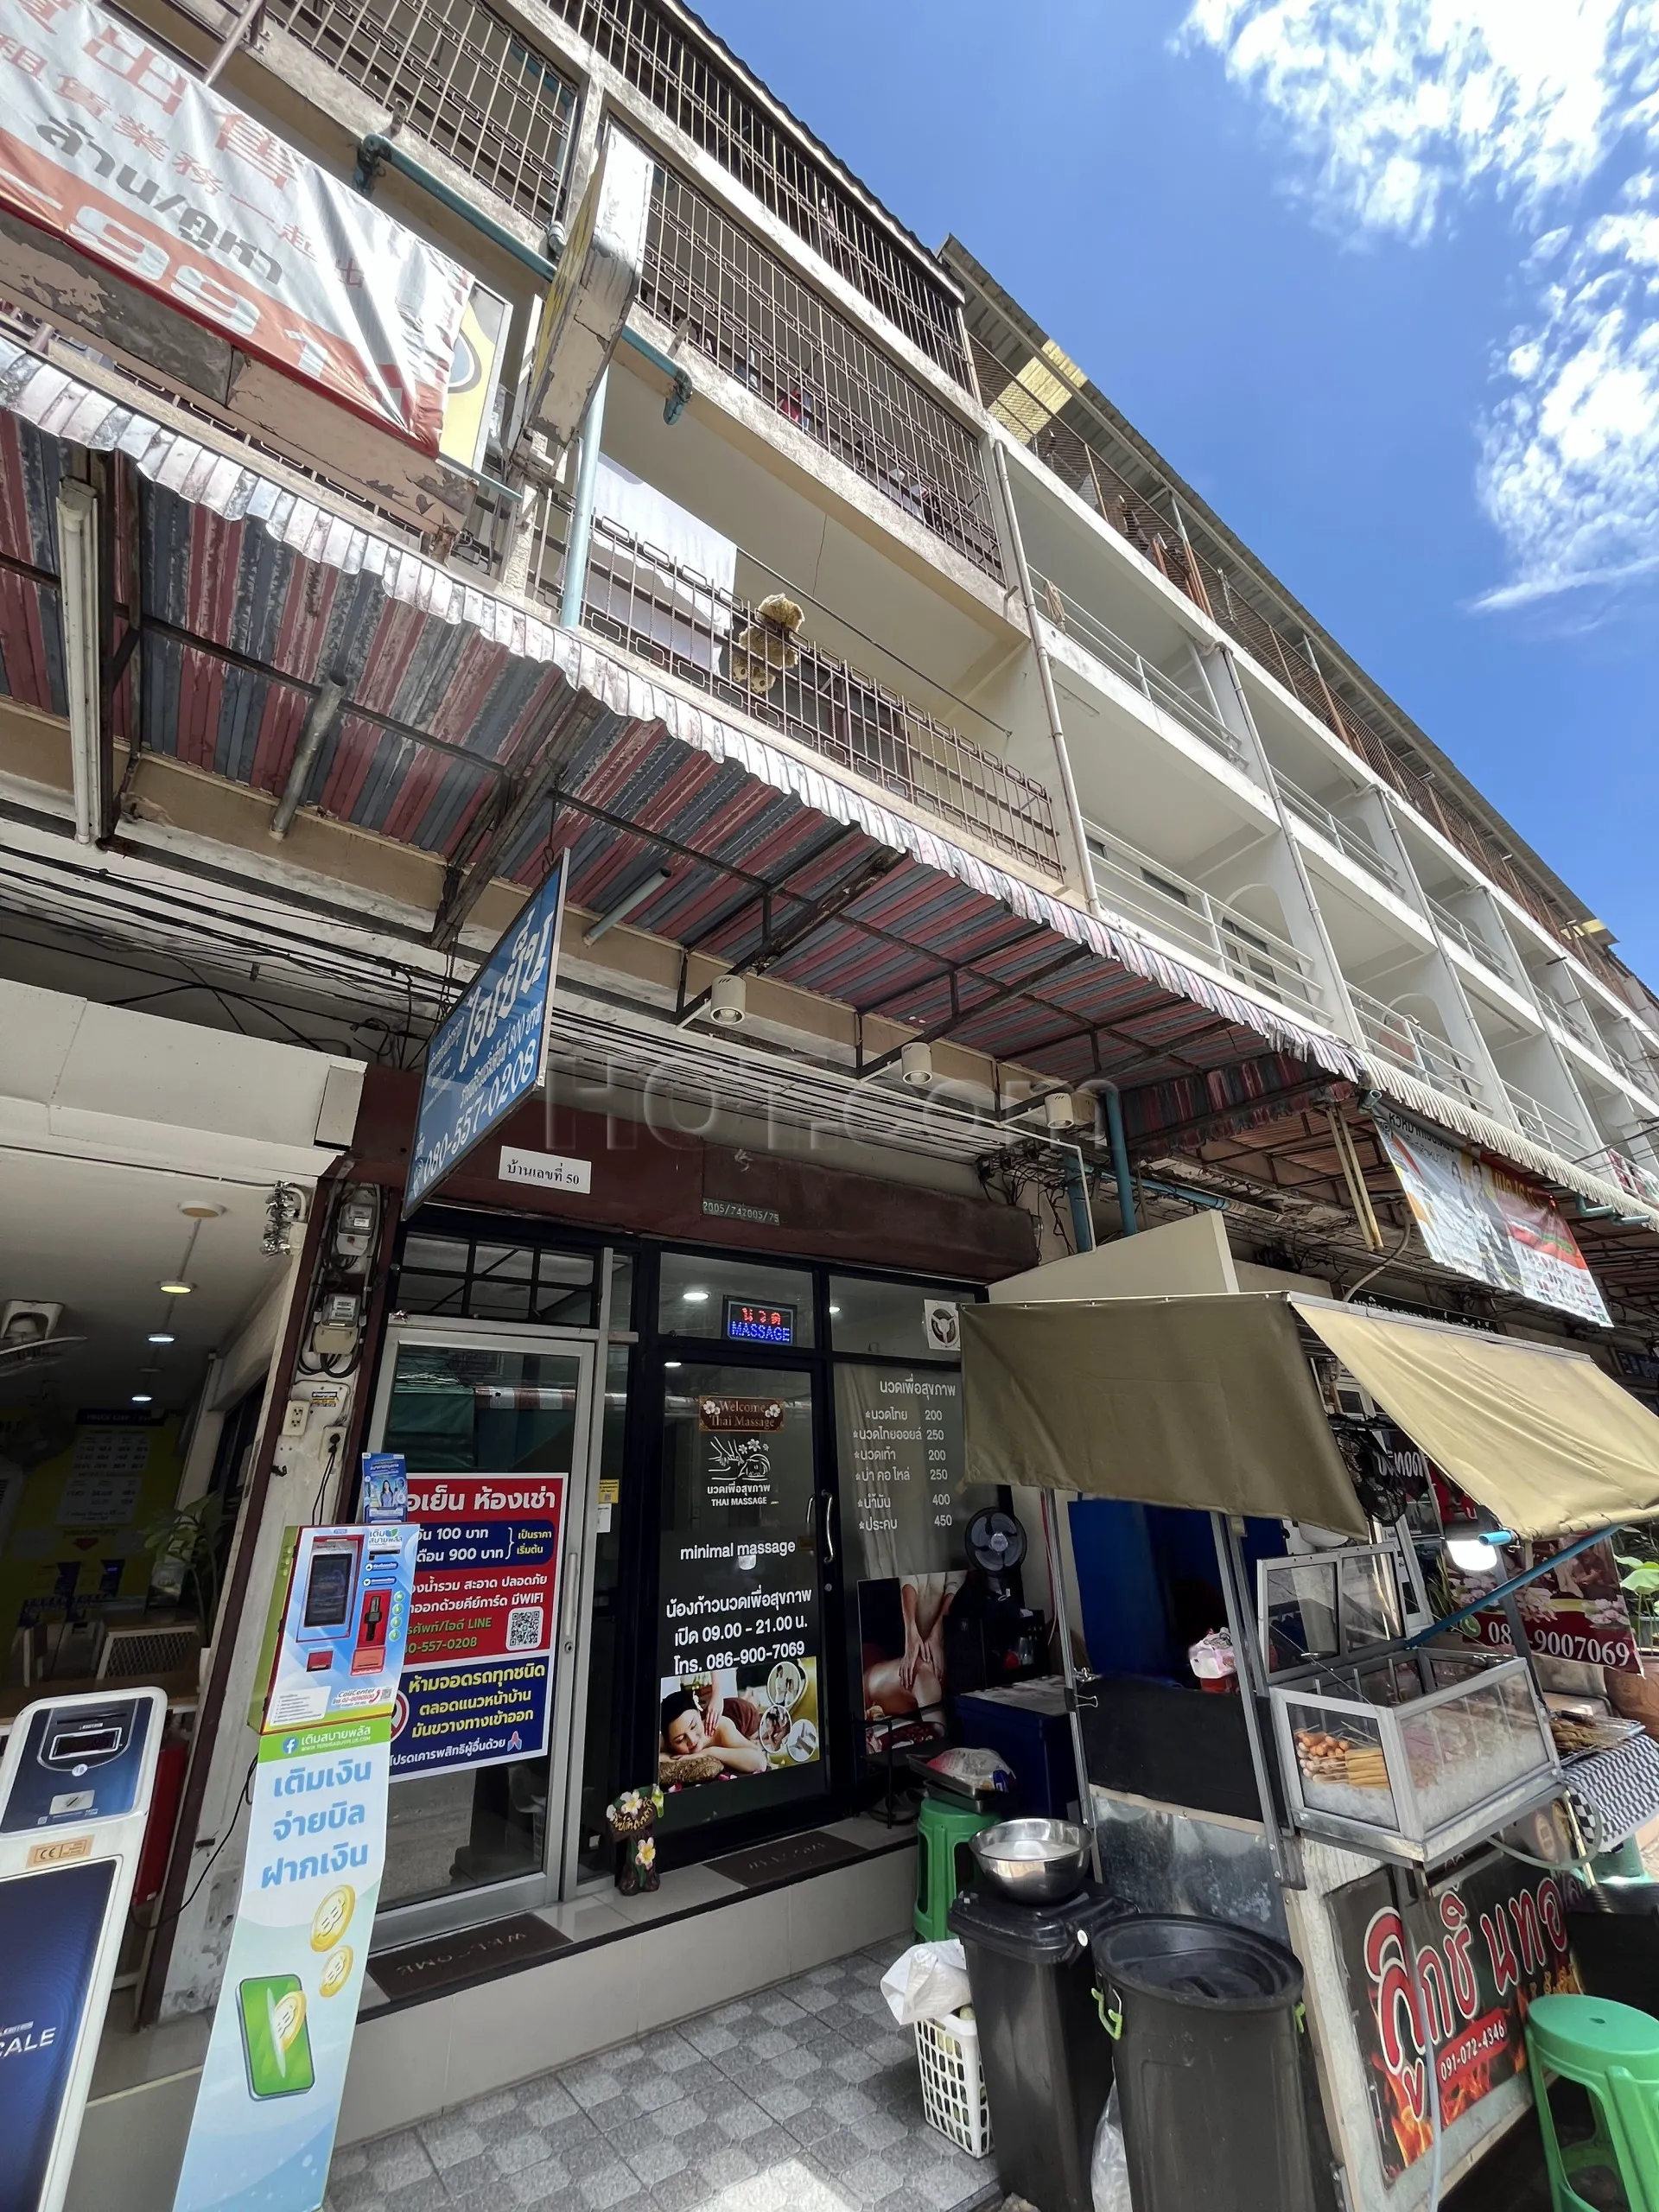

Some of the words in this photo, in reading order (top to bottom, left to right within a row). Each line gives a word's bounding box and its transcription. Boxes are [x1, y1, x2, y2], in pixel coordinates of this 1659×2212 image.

[35, 116, 284, 284] ล้าน/คูหา
[423, 1038, 537, 1185] 080-557-0208
[506, 1159, 563, 1183] บ้านเลขที่
[566, 1173, 580, 1185] 50
[731, 1320, 791, 1342] MASSAGE
[880, 1374, 957, 1401] นวดเพื่อสุขภาพ
[718, 1400, 766, 1414] Welcome
[871, 1407, 908, 1421] นวดไทย
[925, 1409, 943, 1421] 200
[709, 1415, 732, 1427] Thai
[734, 1415, 776, 1430] Massage
[859, 1426, 922, 1440] นวดไทยออยล์
[926, 1429, 944, 1440] 250
[861, 1446, 896, 1460] นวดเท้า
[928, 1449, 946, 1461] 200
[877, 1470, 891, 1481] คอ
[930, 1469, 948, 1480] 250
[474, 1485, 556, 1510] ห้องเช่า
[707, 1481, 771, 1496] นวดเพื่อสุขภาพ
[711, 1498, 729, 1507] THAI
[731, 1497, 767, 1506] MASSAGE
[932, 1493, 950, 1505] 400
[865, 1516, 898, 1531] ประคบ
[934, 1514, 952, 1527] 450
[436, 1527, 461, 1540] 100
[466, 1529, 489, 1539] บาท
[518, 1529, 552, 1540] เป็นราคา
[448, 1548, 476, 1560] 900
[480, 1548, 504, 1560] บาท
[517, 1543, 543, 1554] เริ่มต้น
[680, 1542, 734, 1560] minimal
[737, 1541, 796, 1556] massage
[464, 1579, 498, 1590] สะอาด
[501, 1573, 548, 1588] ปลอดภัย
[512, 1592, 543, 1605] มีWIFI
[666, 1585, 812, 1618] น้องก้าวนวดเพื่อสุขภาพ
[467, 1618, 493, 1630] LINE
[675, 1626, 699, 1647] เปิด
[702, 1622, 742, 1643] 09.00
[755, 1615, 792, 1635] 21.00
[795, 1615, 808, 1629] น.
[405, 1637, 478, 1655] 0-557-0208
[1488, 1621, 1630, 1668] 08-9007069
[674, 1655, 702, 1675] โทร.
[706, 1640, 805, 1670] 086-900-7069
[408, 1662, 546, 1694] ห้ามจอดรถทุกชนิด
[419, 1688, 531, 1716] ตลอดแนวหน้าบ้าน
[411, 1709, 534, 1738] มันขวางทางเข้าออก
[389, 1737, 506, 1766] โปรดเคารพสิทธิผู้อื่นด้วย
[273, 1758, 372, 1797] เติมเงิน
[273, 1800, 365, 1841] จ่ายบิล
[261, 1841, 369, 1889] ฝากเงิน
[1440, 2019, 1506, 2082] 091-072-4346
